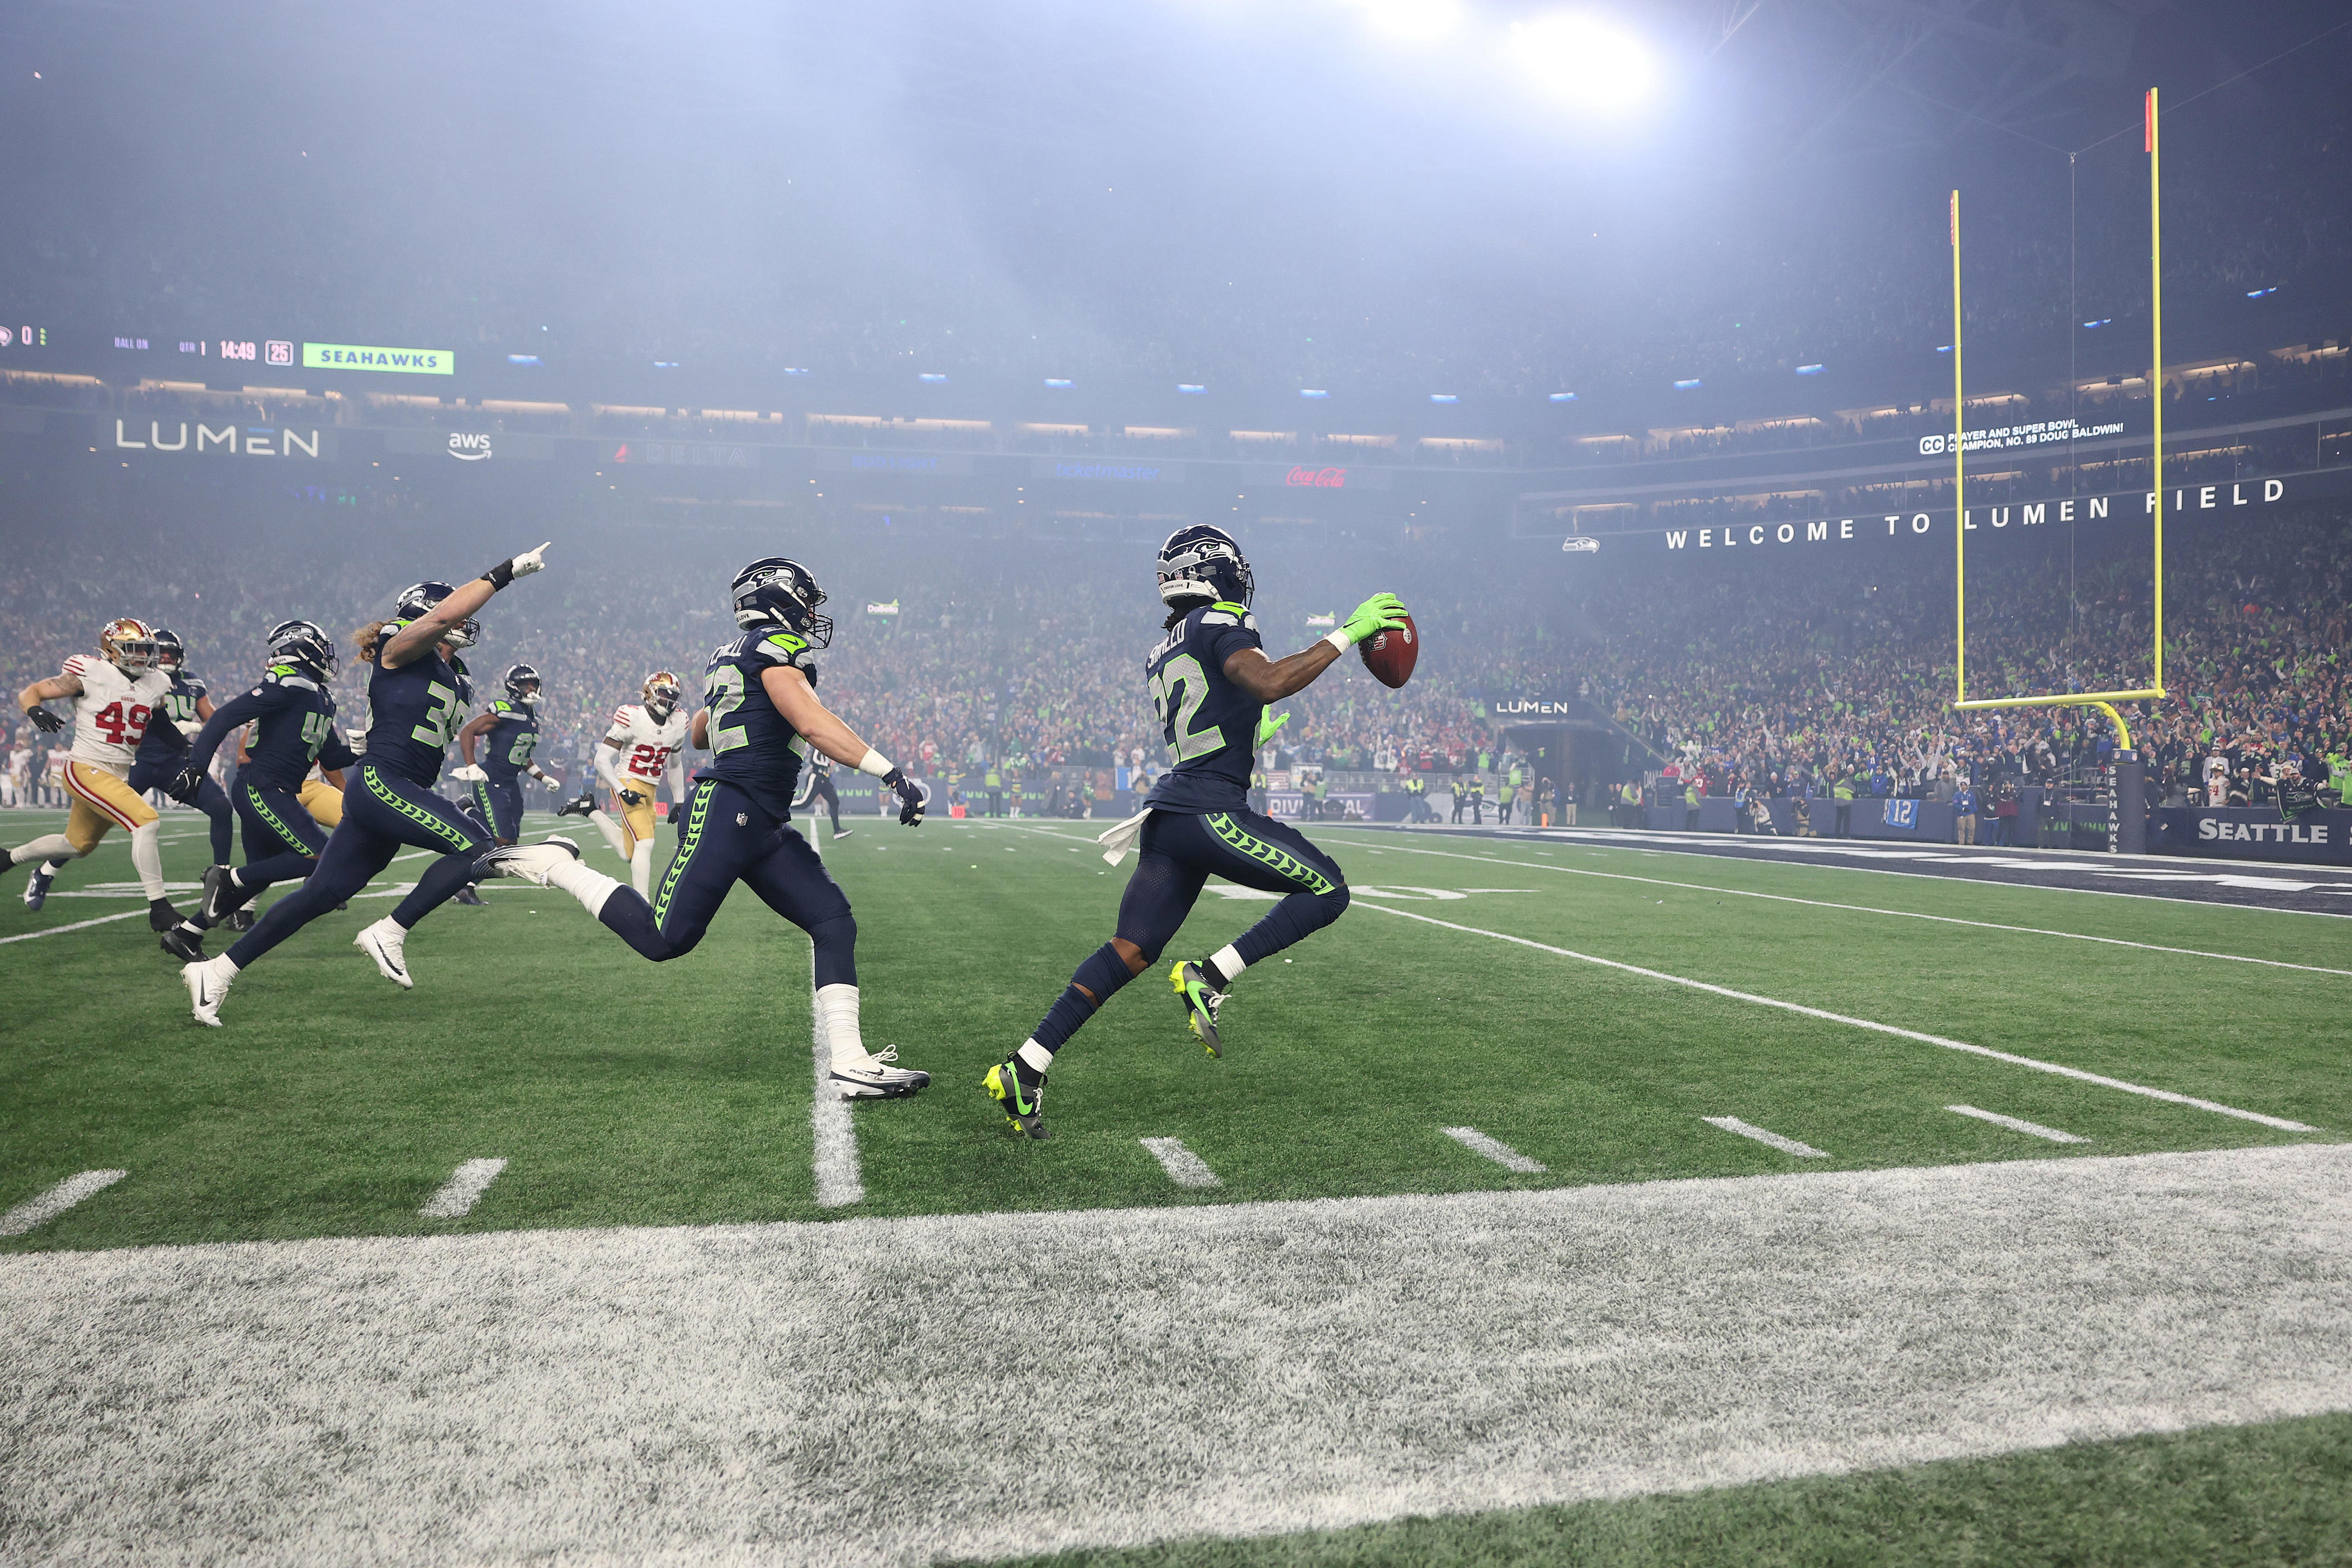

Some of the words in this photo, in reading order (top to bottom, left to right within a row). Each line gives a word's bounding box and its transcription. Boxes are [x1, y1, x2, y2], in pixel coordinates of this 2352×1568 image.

[22, 325, 32, 345] 0
[200, 341, 206, 356] 1
[220, 339, 256, 361] 14:49
[271, 343, 289, 362] 25
[321, 351, 437, 368] SEAHAWKS
[116, 418, 319, 458] LUMEN
[1988, 427, 2010, 438] AND
[2013, 422, 2046, 436] SUPER
[2048, 418, 2079, 432] BOWL
[2006, 435, 2024, 447] NO.
[2026, 434, 2038, 445] 89
[2039, 430, 2069, 443] DOUG
[2072, 422, 2124, 439] BALDWIN!
[448, 432, 490, 449] aws
[1922, 438, 1942, 452] CC
[647, 443, 747, 465] DELTA
[1056, 461, 1161, 479] ticketmaster
[1666, 519, 1854, 549] WELCOME
[1885, 513, 1930, 535] TO
[1964, 497, 2108, 530] LUMEN
[2146, 479, 2284, 513] FIELD
[1496, 701, 1568, 714] LUMEN
[96, 701, 151, 745] 49
[628, 744, 671, 777] 28
[954, 808, 962, 816] 10
[1893, 799, 1911, 824] 12
[2108, 766, 2120, 854] SEAHAWKS
[2198, 818, 2329, 844] SEATTLE
